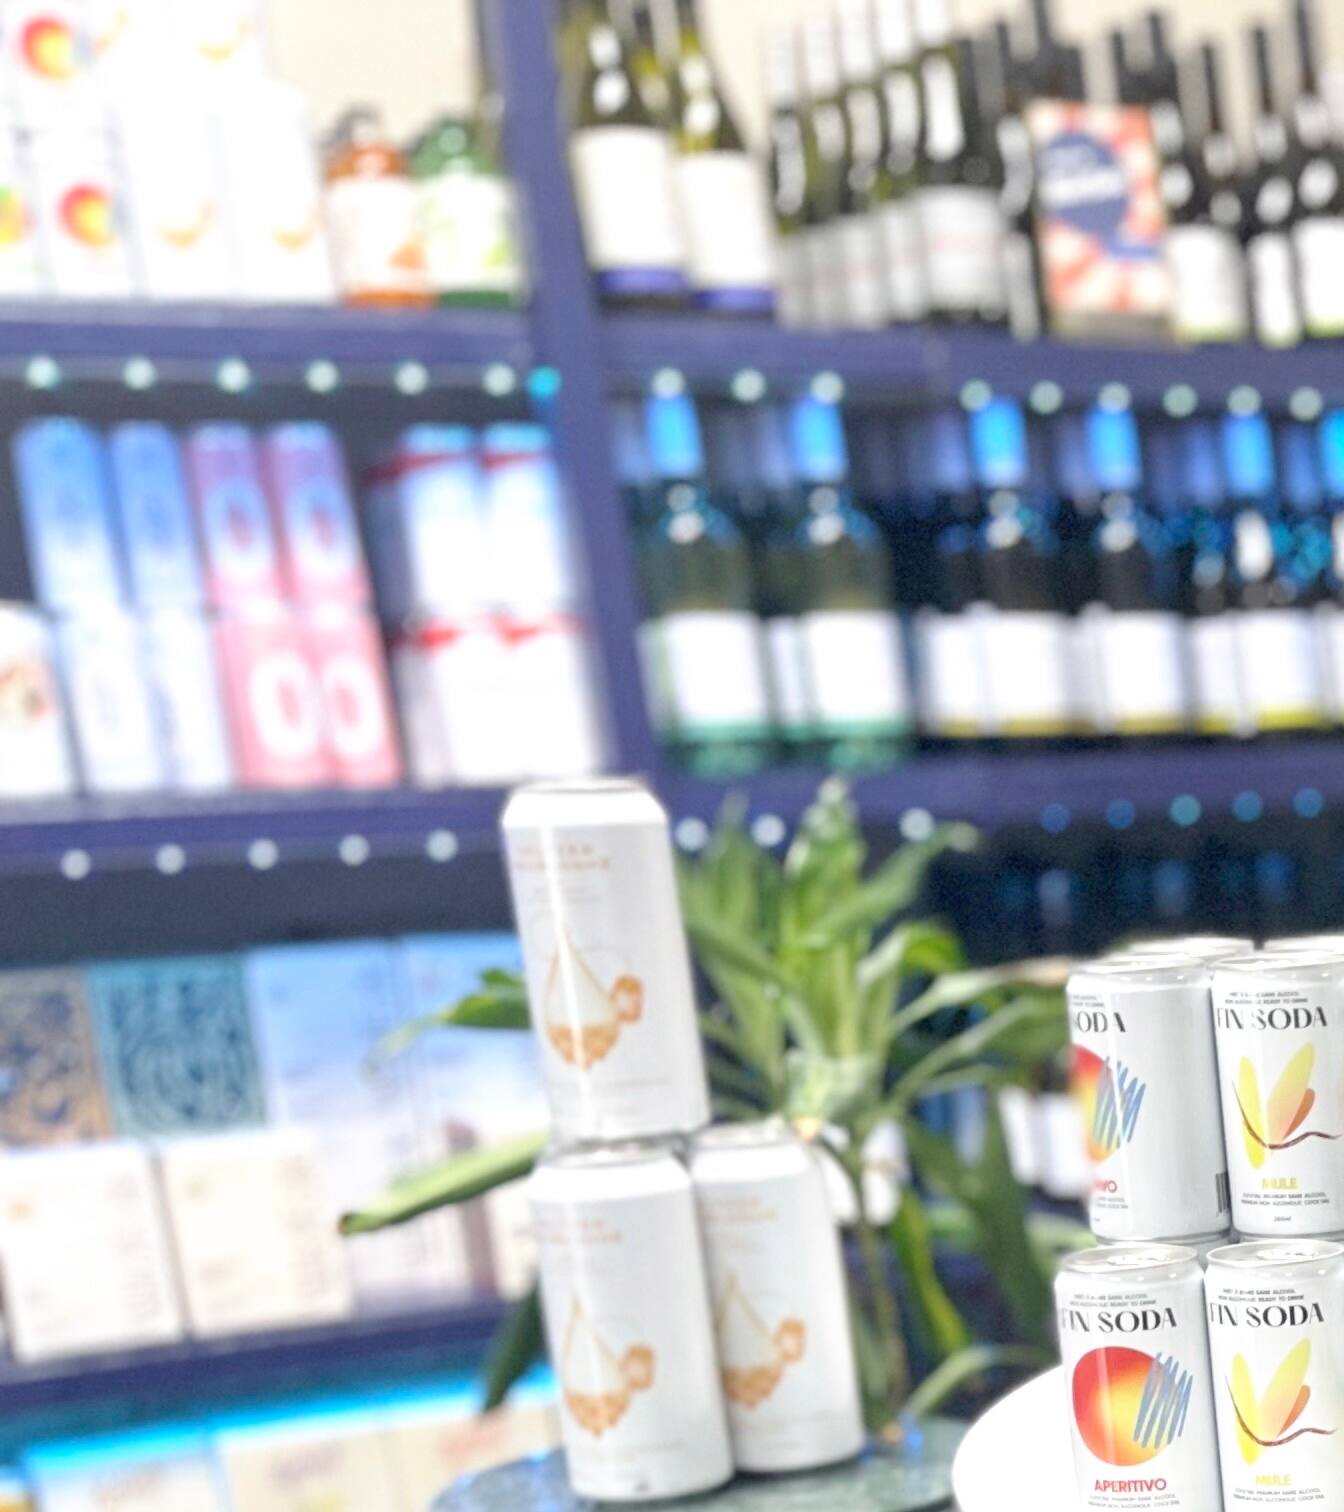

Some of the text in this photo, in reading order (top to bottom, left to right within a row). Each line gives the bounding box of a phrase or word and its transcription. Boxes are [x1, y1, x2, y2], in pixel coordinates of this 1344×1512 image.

[1251, 1006, 1328, 1031] SODA
[1098, 1307, 1177, 1332] SODA
[1246, 1303, 1325, 1328] SODA
[1095, 1479, 1167, 1492] APERITIVO
